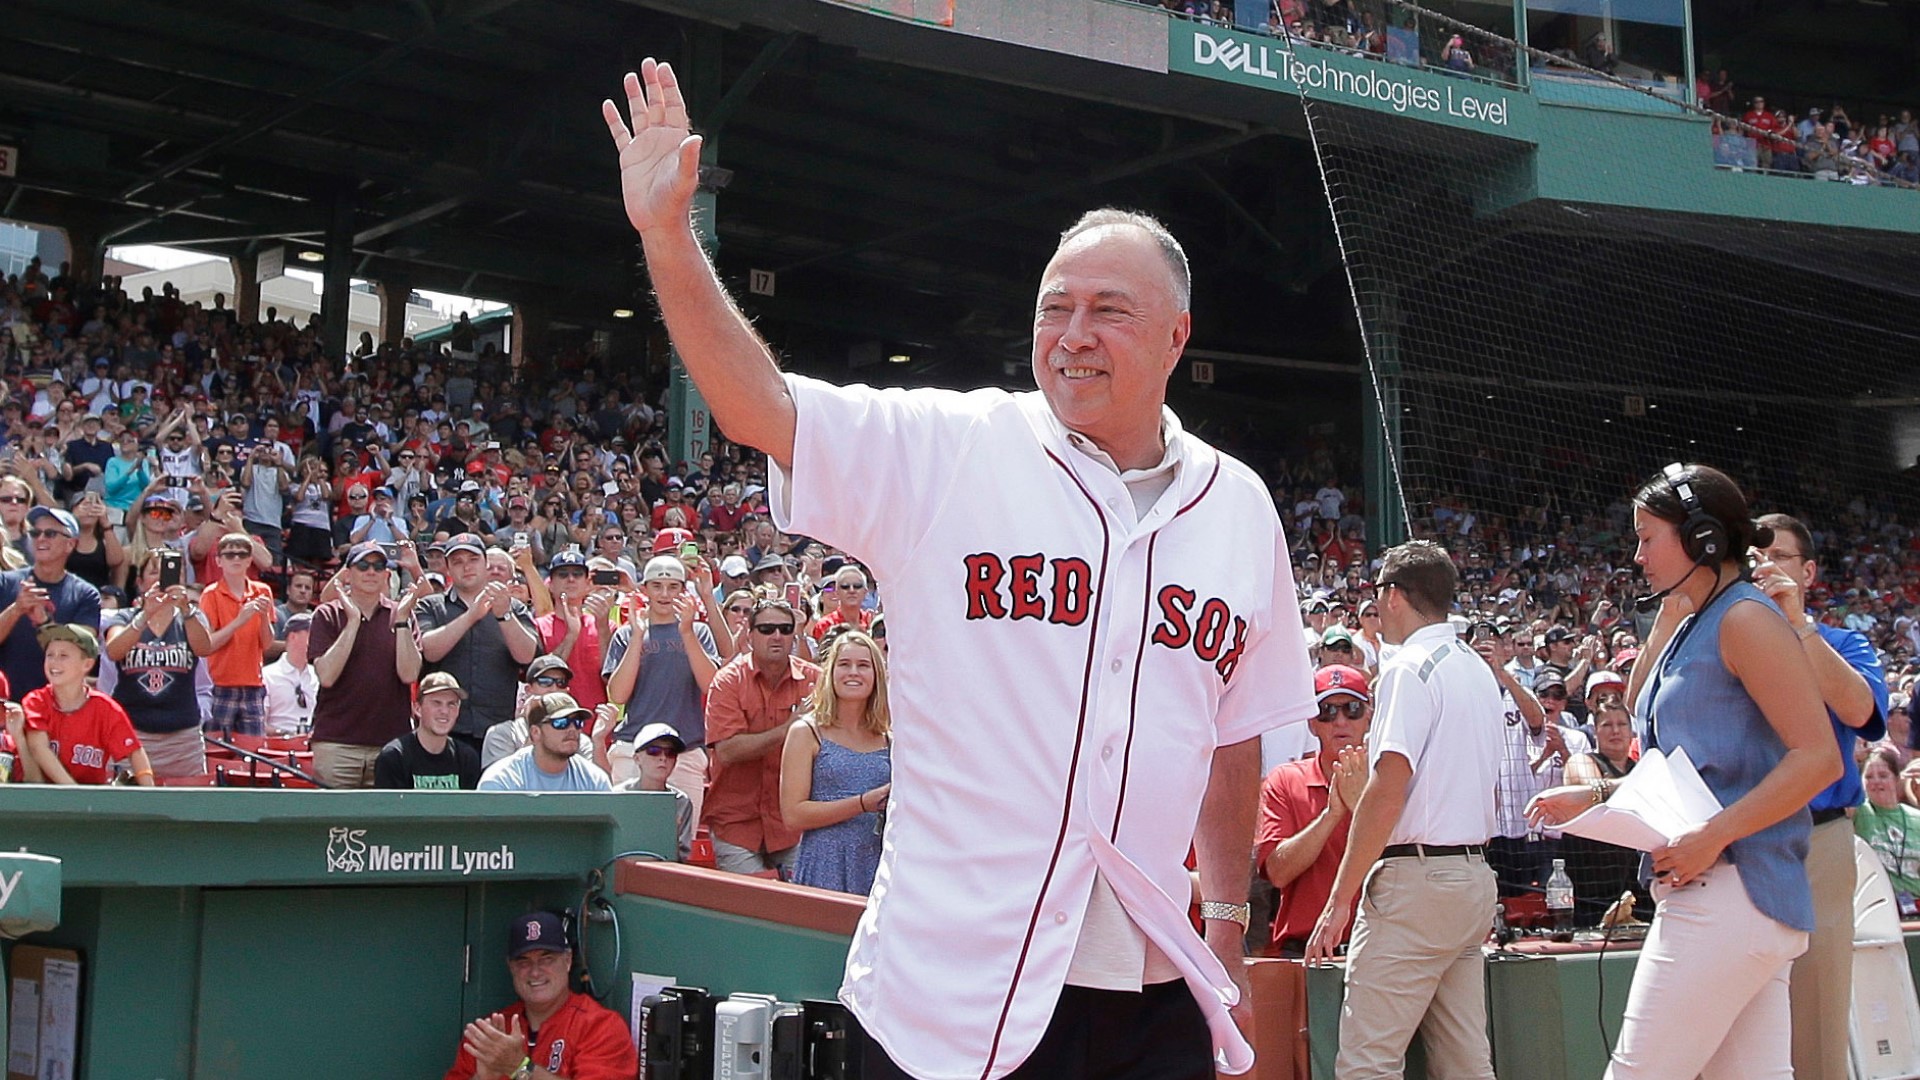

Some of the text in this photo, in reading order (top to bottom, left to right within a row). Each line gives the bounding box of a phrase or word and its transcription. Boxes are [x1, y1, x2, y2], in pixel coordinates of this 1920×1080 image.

[1193, 33, 1508, 126] DELL Technologies Level
[756, 273, 770, 291] 17
[1195, 364, 1209, 380] 18
[691, 409, 705, 428] 16
[690, 440, 705, 459] 17
[963, 552, 1248, 684] RED SOX
[369, 845, 515, 875] Merrill Lynch
[526, 920, 542, 941] B
